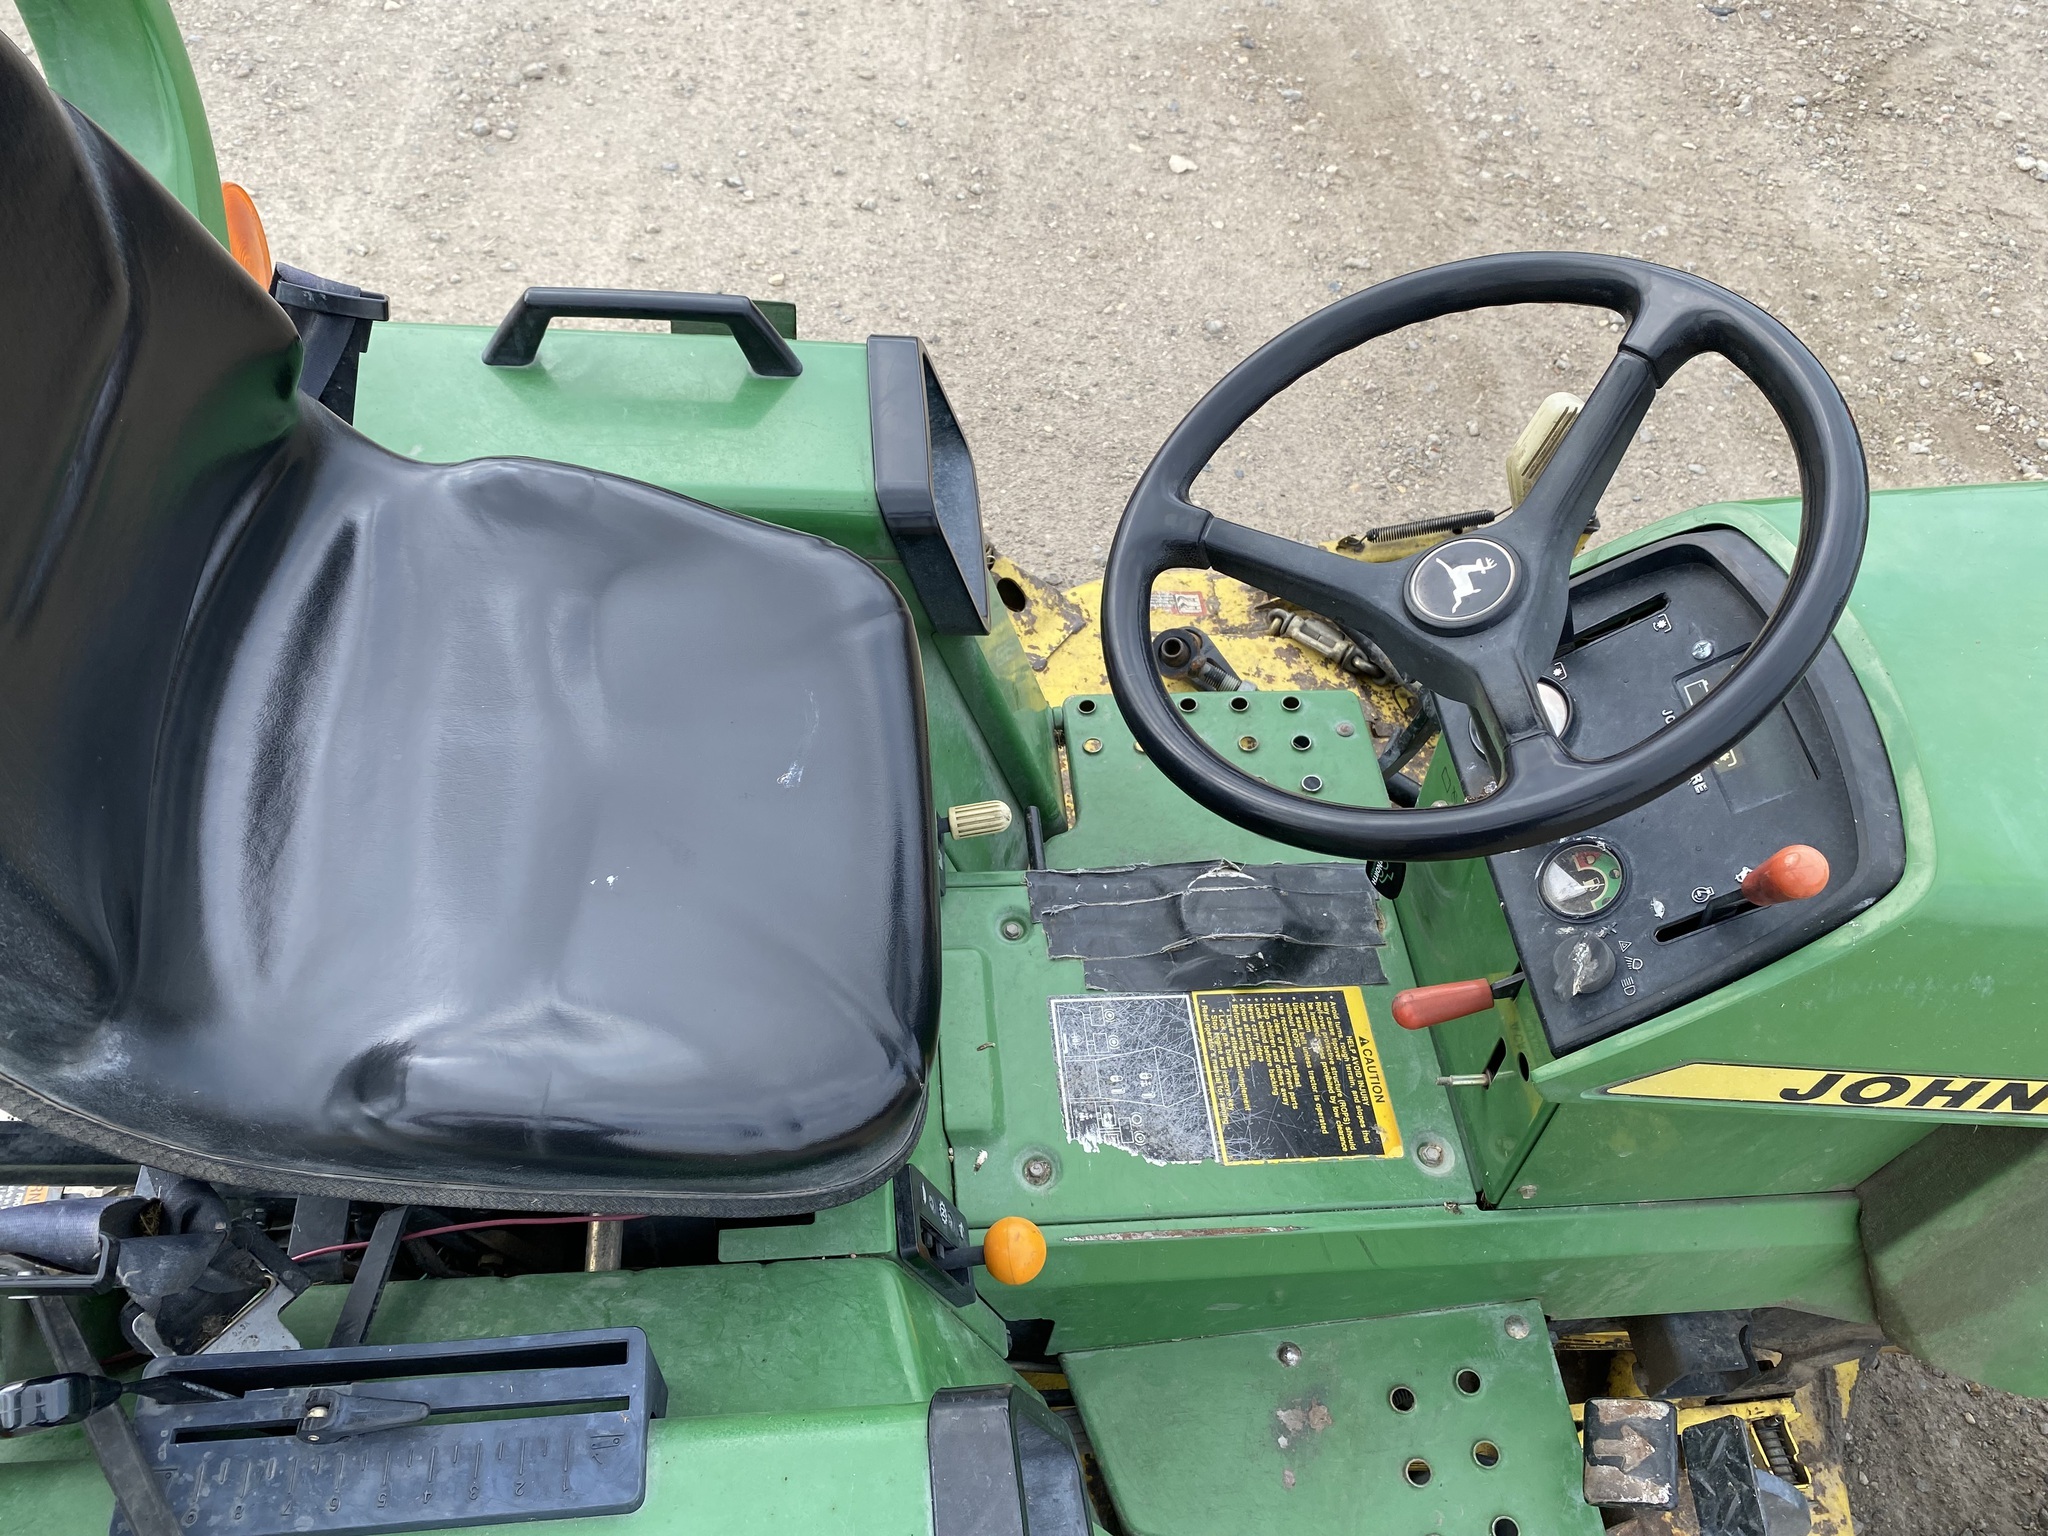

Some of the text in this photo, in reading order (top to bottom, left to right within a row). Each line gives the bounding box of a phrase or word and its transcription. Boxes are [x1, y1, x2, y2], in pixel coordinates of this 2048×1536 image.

[1201, 1005, 1210, 1021] Read
[1231, 1004, 1241, 1025] Before
[1291, 1002, 1299, 1014] Use
[1298, 1002, 1311, 1032] operation
[1307, 1001, 1314, 1009] be
[1329, 1001, 1339, 1019] Avoid
[1226, 1014, 1235, 1034] Lower
[1284, 1002, 1300, 1047] without ROPS
[1294, 1016, 1303, 1030] seat
[1321, 1001, 1330, 1014] may
[1326, 1016, 1335, 1035] cause
[1218, 1014, 1234, 1067] Lock park brake
[1235, 1027, 1246, 1050] leaving
[1239, 1004, 1248, 1021] Know
[1245, 1033, 1256, 1060] controls
[1246, 1003, 1264, 1062] Never carry riders
[1298, 1032, 1307, 1044] belt
[1254, 1003, 1279, 1095] Look behind before backing
[1260, 1003, 1289, 1105] Keep children and others away
[1268, 1003, 1299, 1109] Stay clear of power driven parts
[1276, 1002, 1301, 1087] Use recommended ballast
[1338, 1042, 1350, 1061] rough
[1209, 1014, 1235, 1110] Stop engine and remove key
[1301, 1046, 1312, 1068] unless
[1211, 1059, 1222, 1083] manual
[1307, 1070, 1318, 1092] tractor
[1320, 1061, 1334, 1093] prohibited
[1345, 1035, 1369, 1106] HELP AVOID INJURY
[1361, 1048, 1385, 1103] CAUTION
[1216, 1086, 1224, 1095] for
[1321, 1032, 1335, 1064] protective
[1330, 1066, 1343, 1097] structure
[1337, 1099, 1350, 1124] (ROPS)
[1344, 1126, 1356, 1150] should
[1327, 1095, 1337, 1104] by
[1351, 1090, 1360, 1102] and
[1780, 1073, 2048, 1111] JOHN
[1314, 1103, 1328, 1134] operated
[1331, 1106, 1340, 1118] low
[1353, 1105, 1366, 1128] slopes
[1335, 1120, 1348, 1151] clearance
[1361, 1130, 1370, 1143] that
